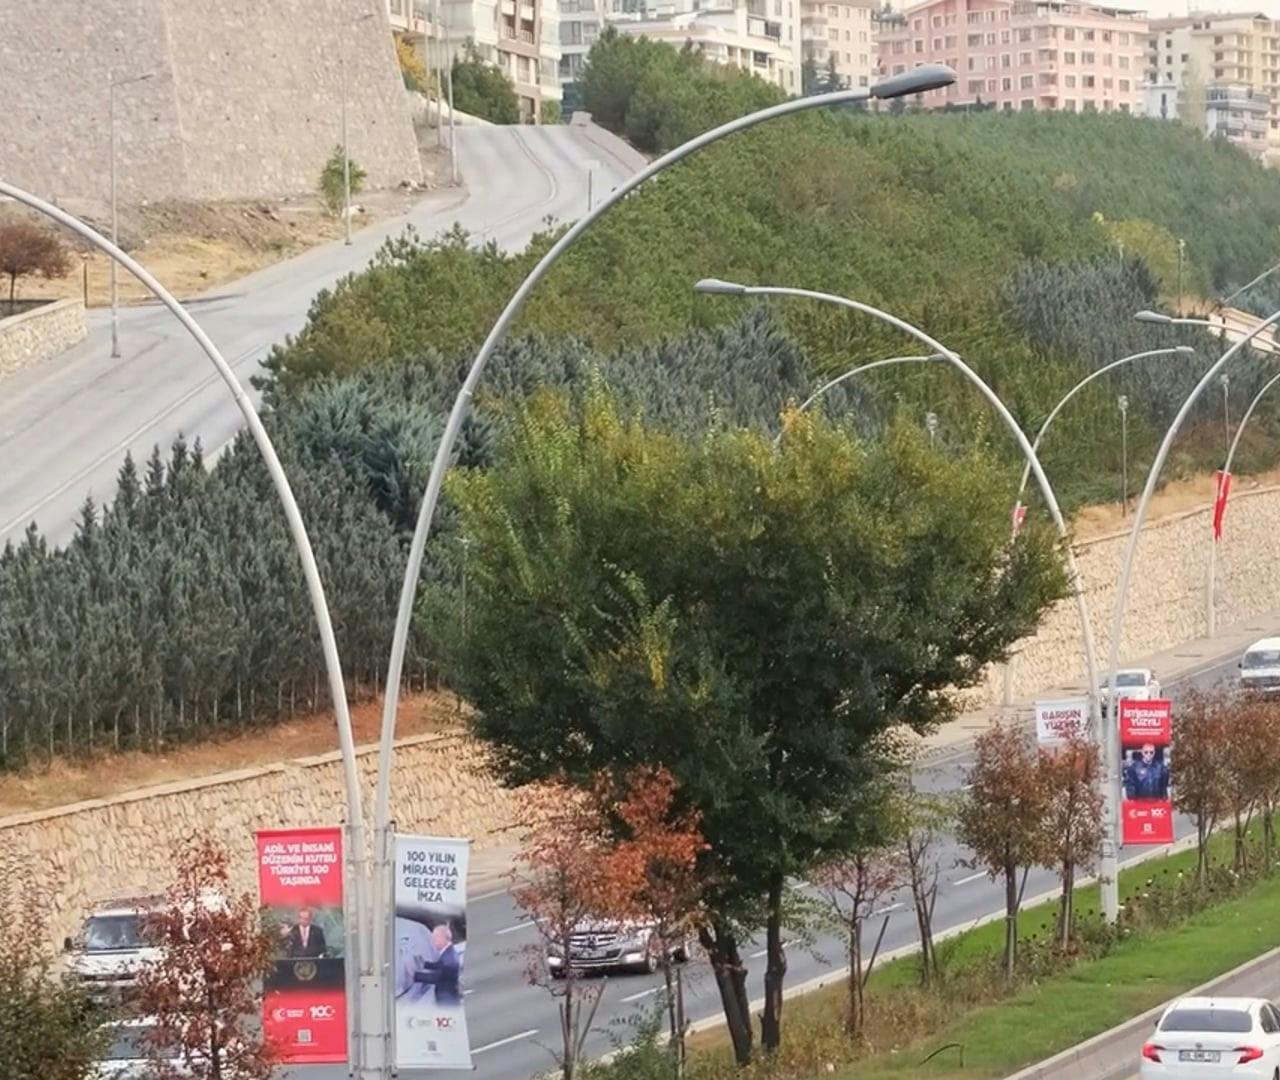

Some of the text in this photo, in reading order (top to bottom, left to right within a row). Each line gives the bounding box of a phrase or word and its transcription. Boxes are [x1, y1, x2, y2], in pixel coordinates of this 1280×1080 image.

[287, 843, 301, 853] VE
[407, 850, 456, 864] 100 YILIN
[270, 864, 329, 875] TÜRKİYE 100
[403, 862, 459, 877] MİRASIYLA
[279, 875, 321, 887] YAŞINDA
[404, 876, 457, 890] GELECEĞE
[417, 887, 443, 902] İMZA
